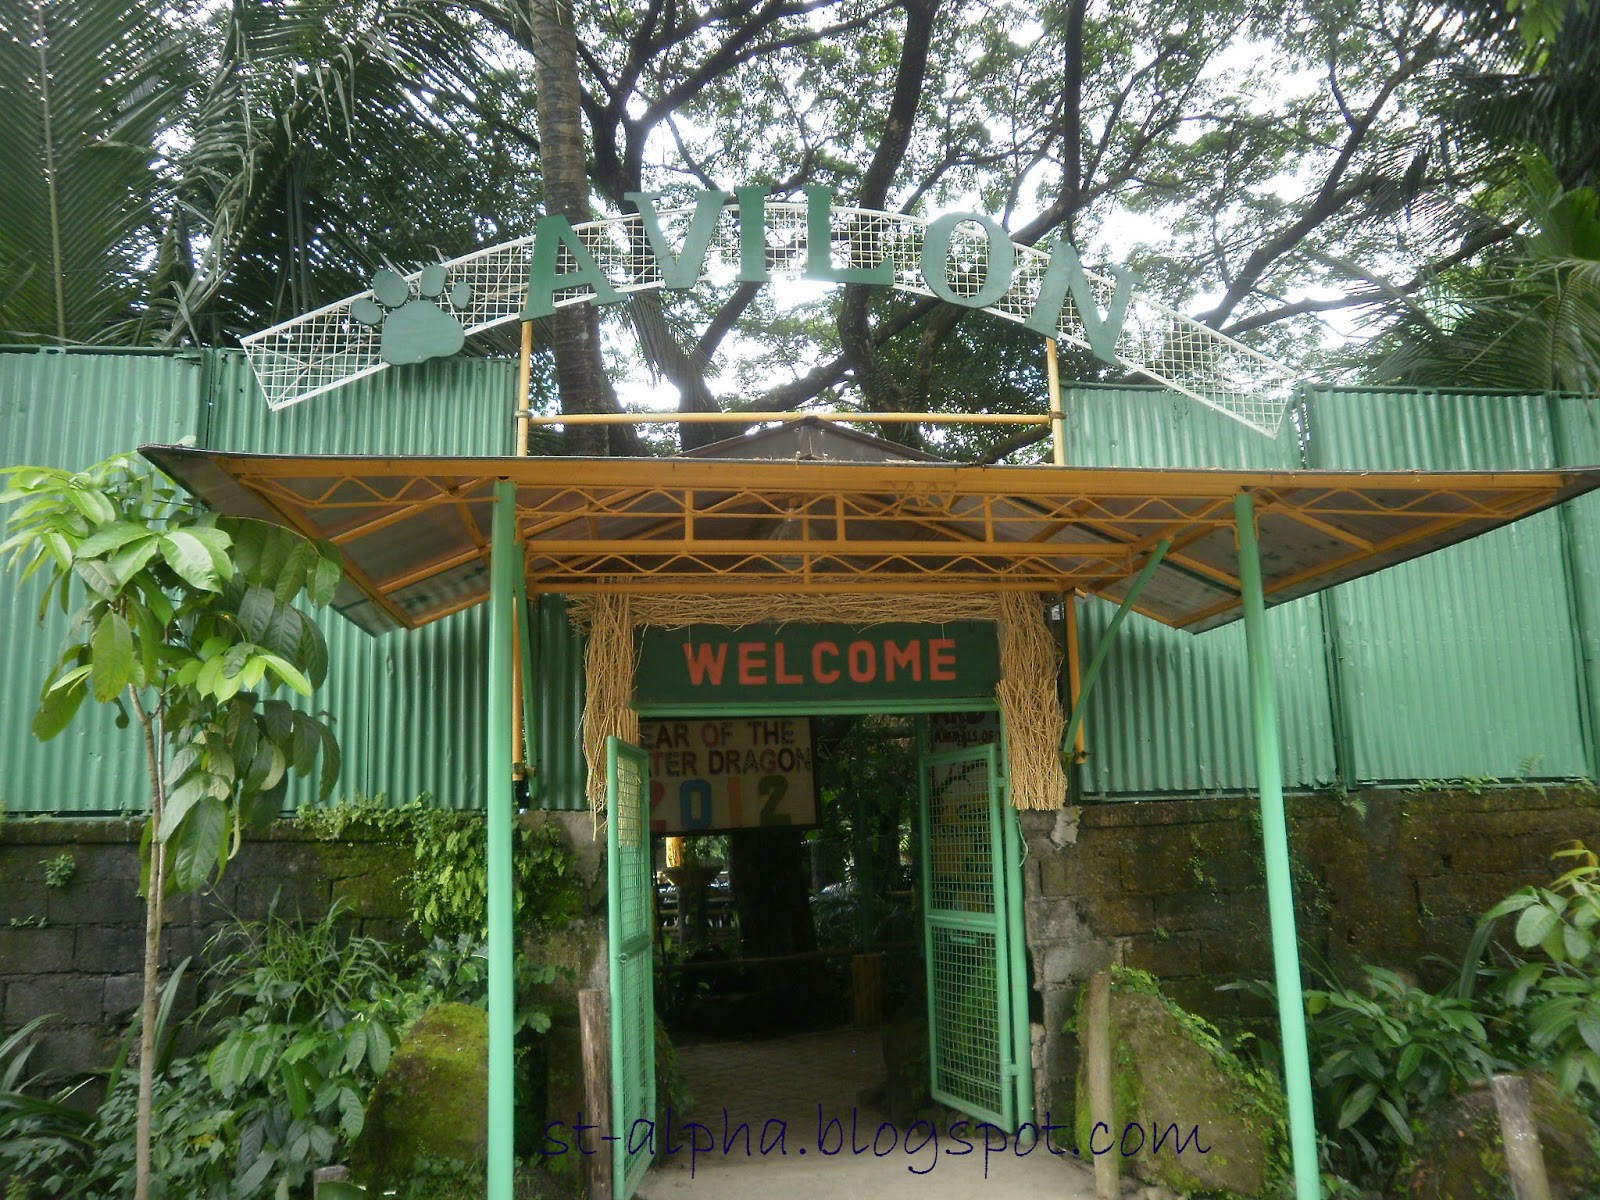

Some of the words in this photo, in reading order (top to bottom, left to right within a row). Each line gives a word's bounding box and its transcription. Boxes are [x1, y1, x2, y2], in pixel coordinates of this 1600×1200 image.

[519, 184, 1145, 368] AVILON
[682, 638, 957, 687] WELCOME
[640, 722, 690, 749] EAR
[701, 722, 734, 748] OF
[748, 719, 795, 745] THE
[649, 751, 697, 776] TER
[708, 747, 814, 775] DRAGON
